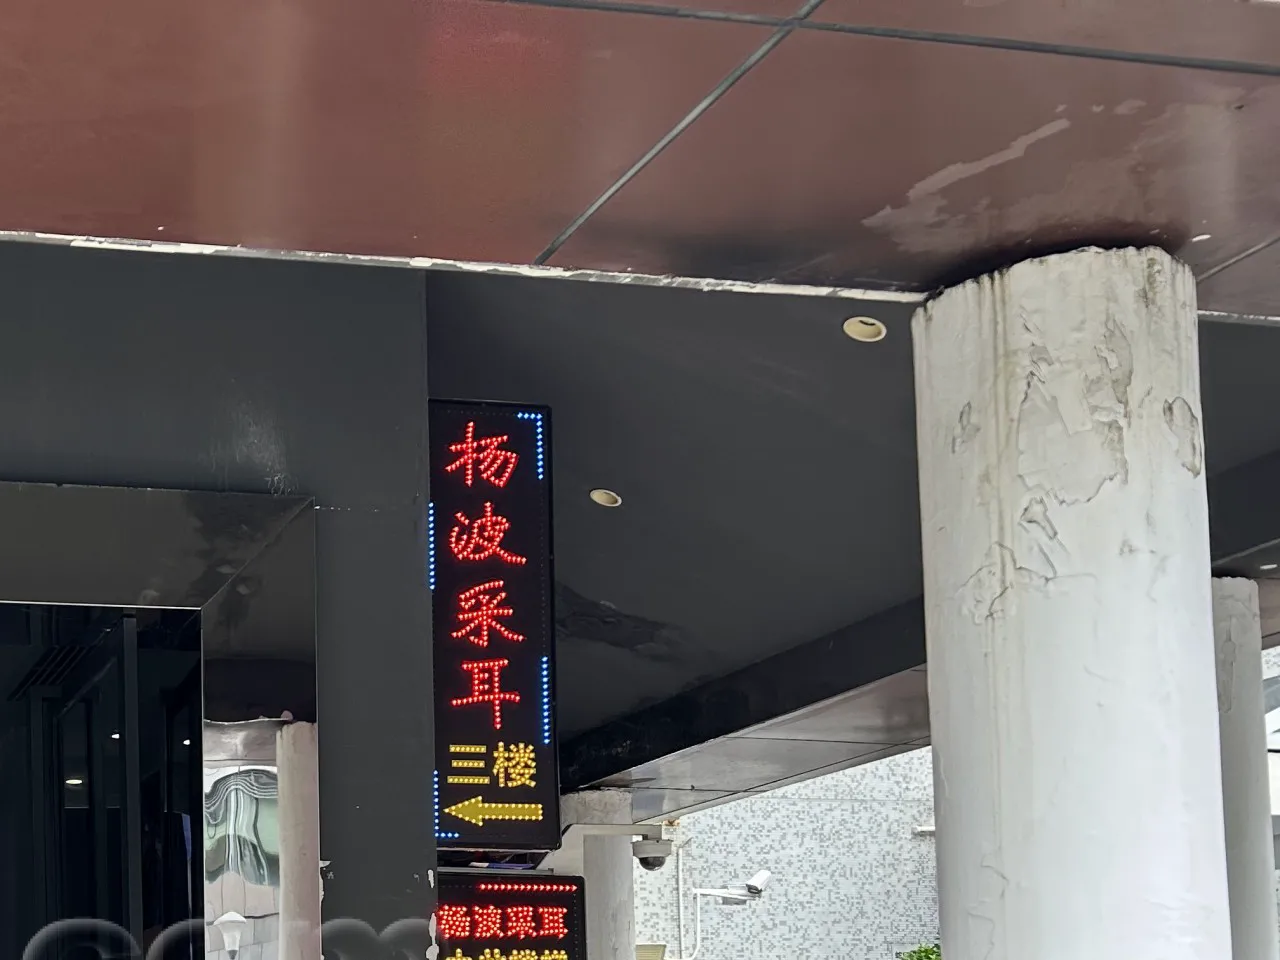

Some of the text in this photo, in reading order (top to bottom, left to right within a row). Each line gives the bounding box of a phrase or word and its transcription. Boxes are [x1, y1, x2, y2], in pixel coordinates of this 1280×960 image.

[444, 421, 527, 730] 杨波采耳
[447, 741, 537, 788] 三楼
